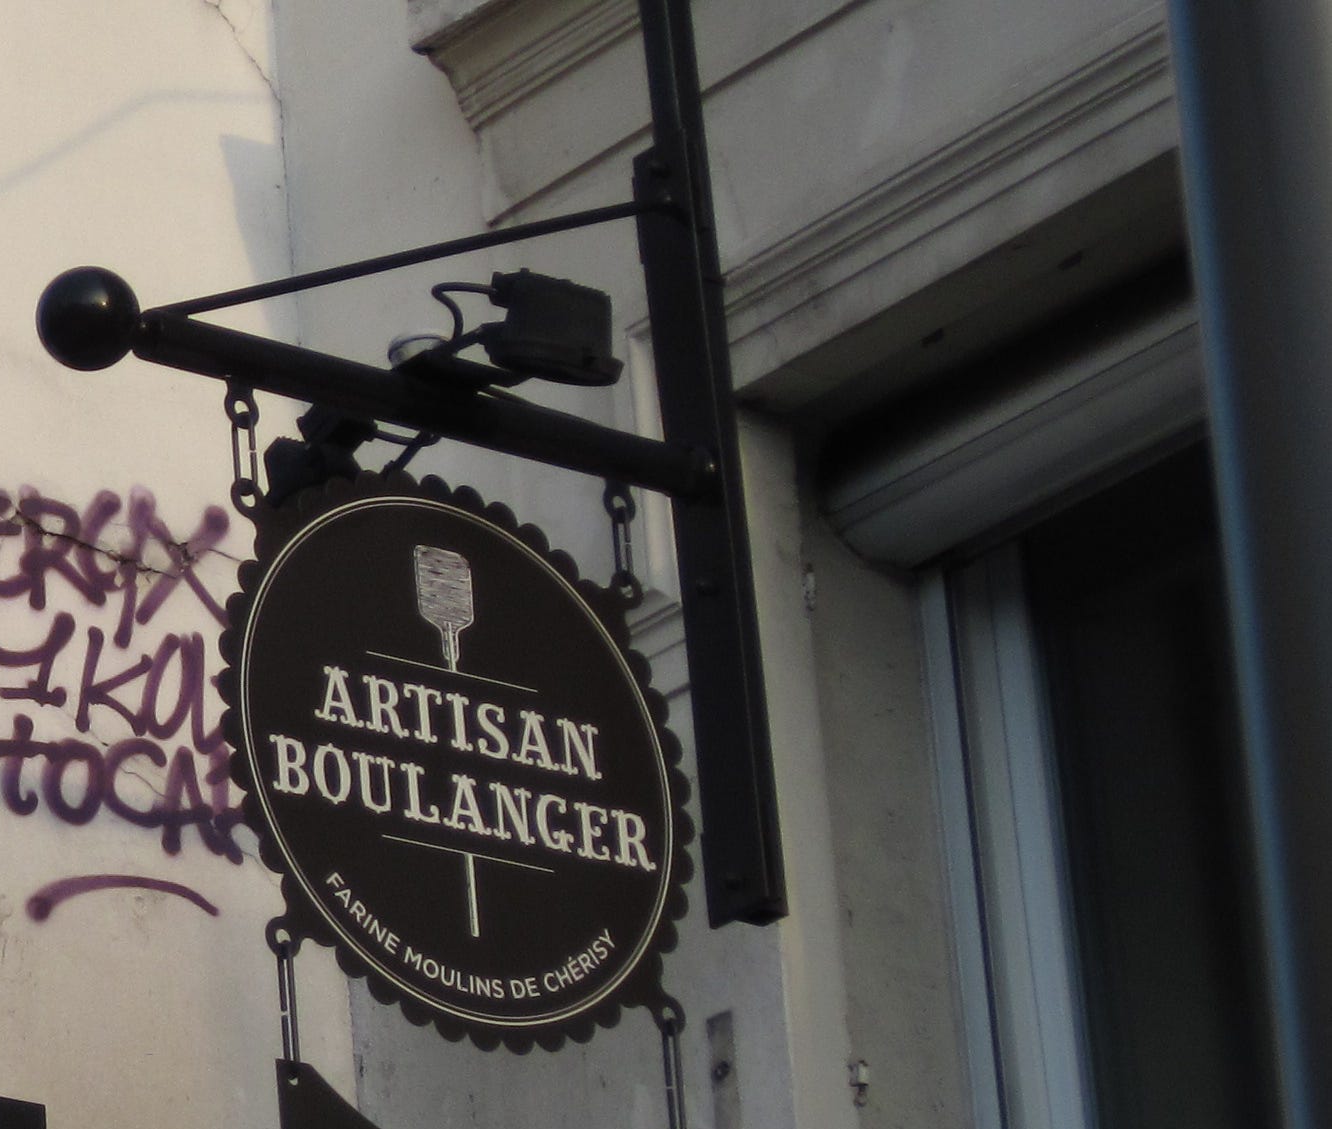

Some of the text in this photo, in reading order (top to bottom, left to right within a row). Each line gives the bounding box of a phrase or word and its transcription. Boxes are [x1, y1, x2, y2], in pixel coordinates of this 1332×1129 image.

[315, 665, 603, 781] ARTISAN
[269, 734, 656, 871] BOULANGER
[326, 872, 616, 999] FARINE MOULINS DE CHÉRISY
